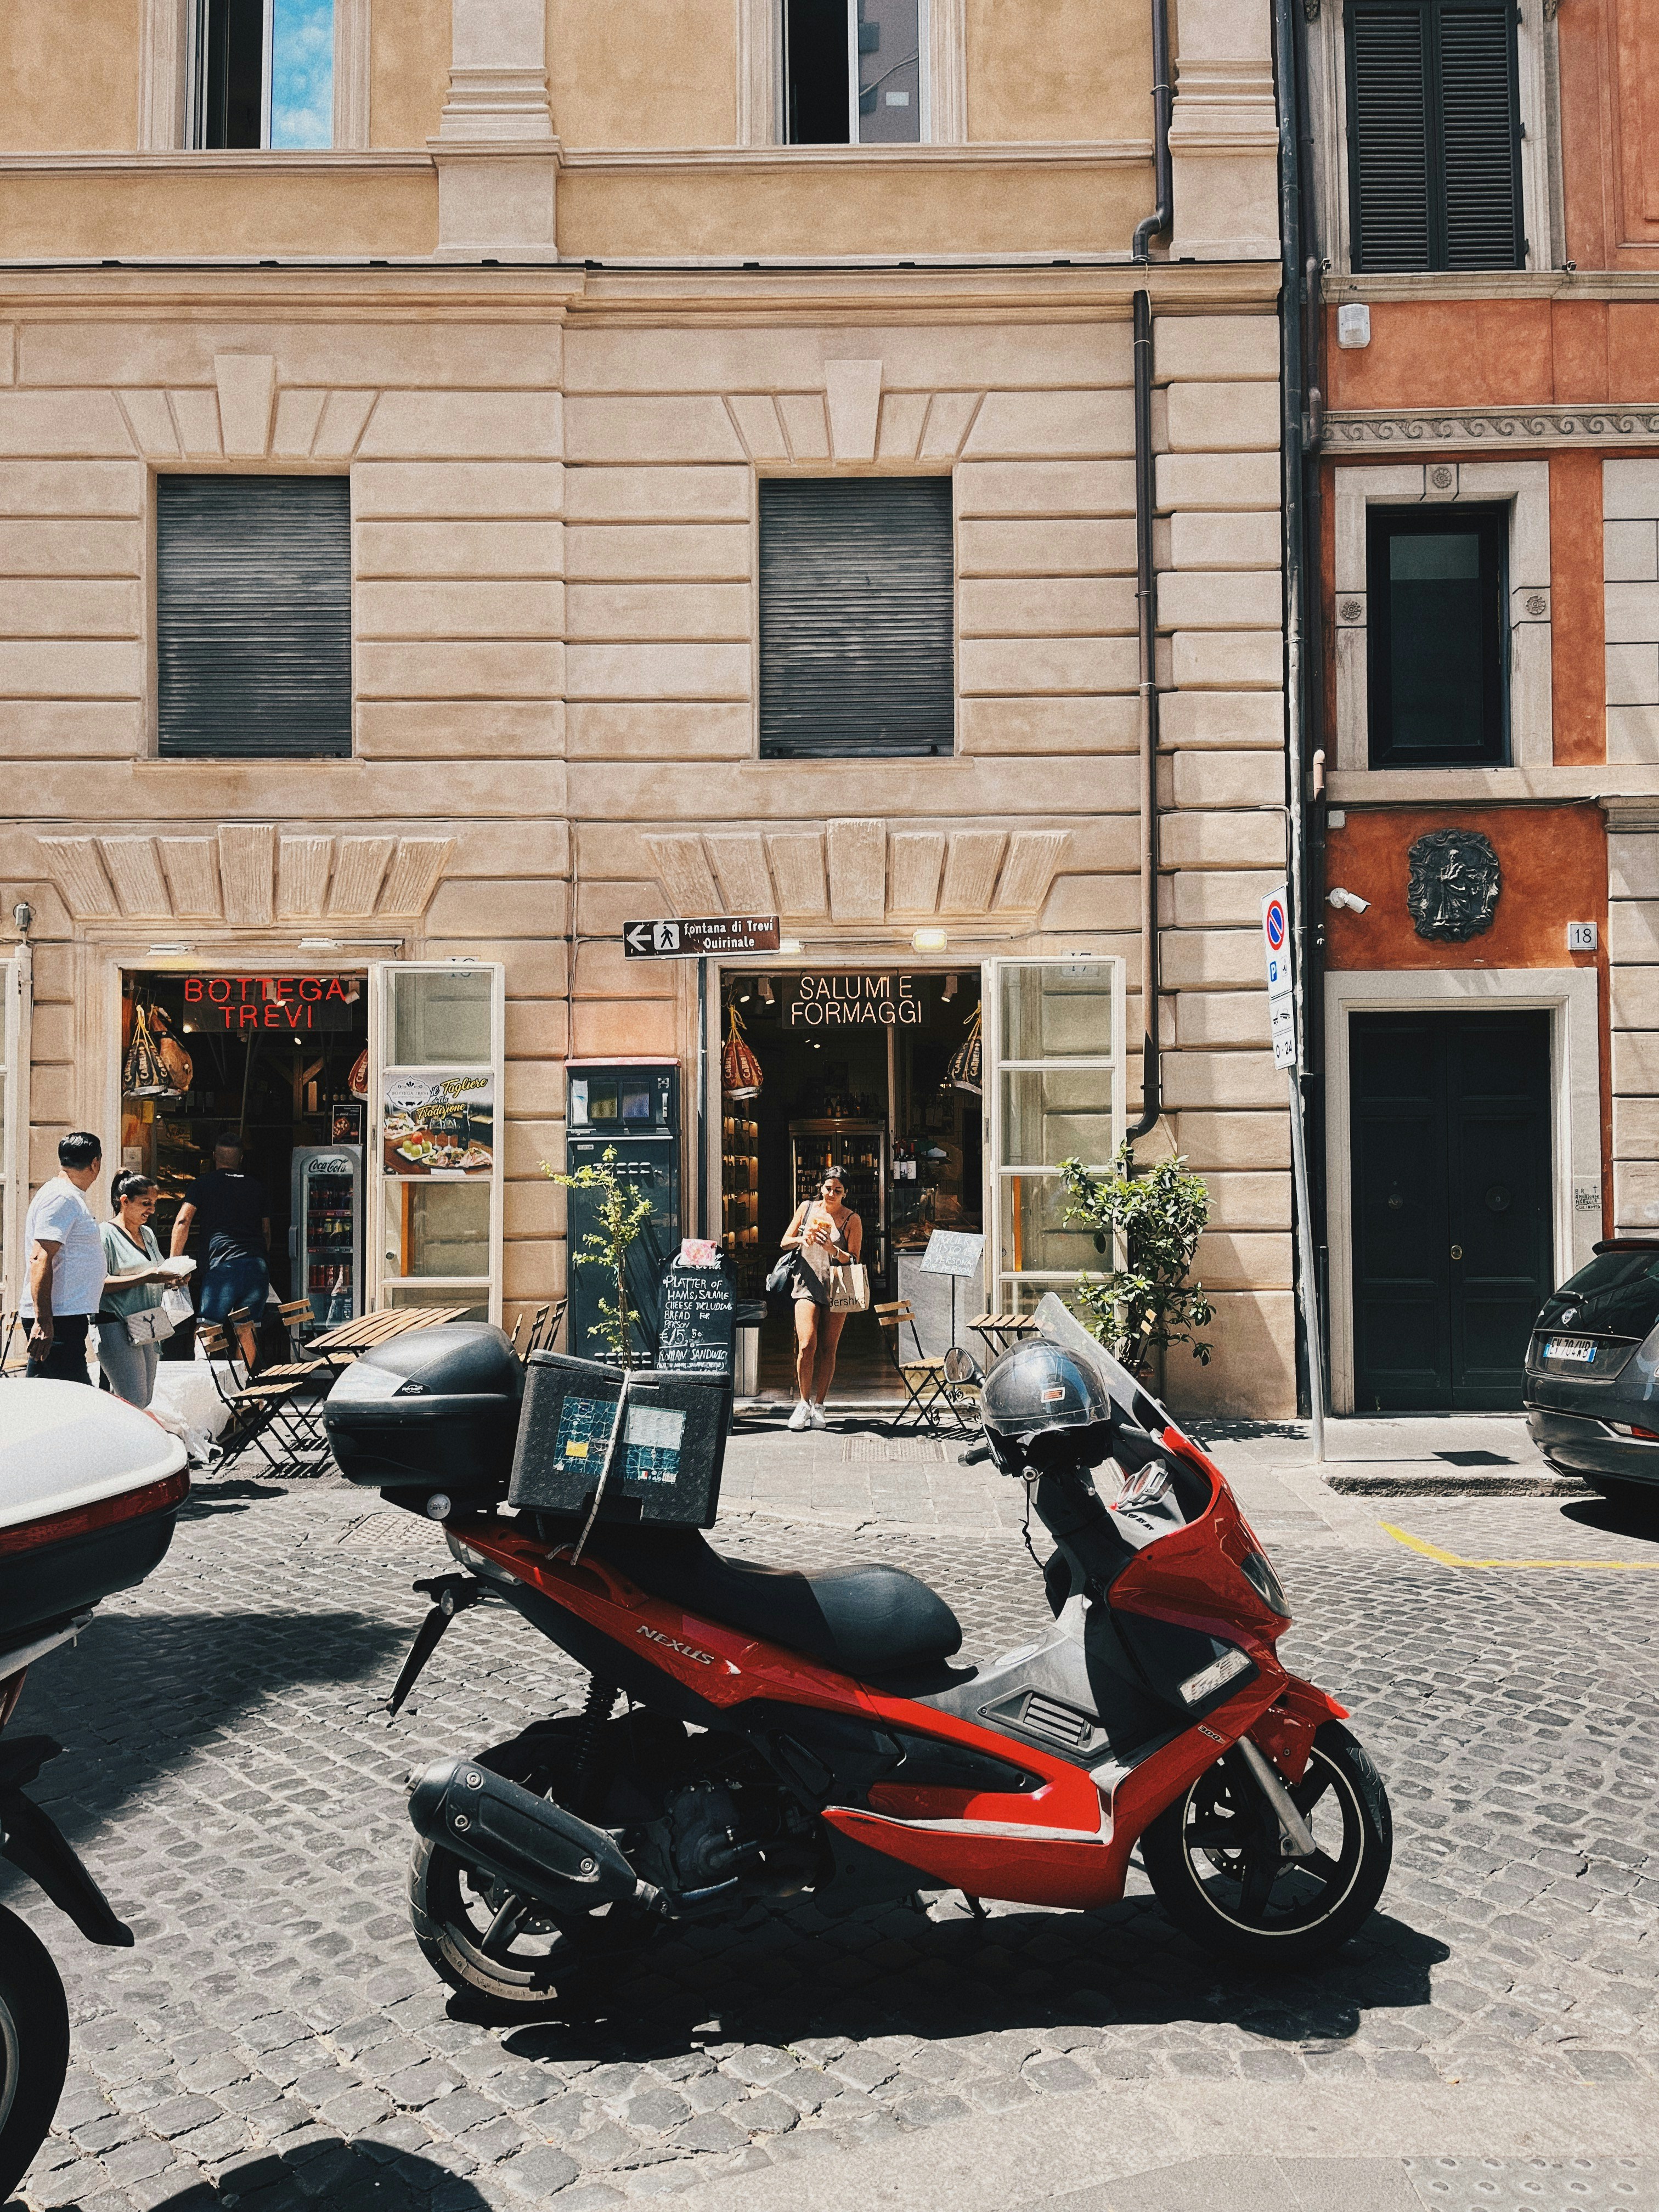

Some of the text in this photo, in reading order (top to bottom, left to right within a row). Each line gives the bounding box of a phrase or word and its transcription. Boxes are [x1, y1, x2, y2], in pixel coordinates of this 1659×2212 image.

[684, 919, 773, 935] fontana di Trevi
[704, 935, 755, 949] Quirinale
[1575, 928, 1592, 943] 18
[185, 978, 346, 1002] BOTTEGA
[800, 976, 913, 1000] SALUMI E
[218, 1005, 312, 1028] TREVI
[792, 1000, 921, 1025] FORMAGGI
[440, 1077, 488, 1098] Tagliere
[432, 1096, 449, 1104] della
[416, 1103, 465, 1120] Tradizione
[665, 1275, 723, 1290] PLATTER OF
[665, 1301, 693, 1310] CHEESE
[664, 1310, 691, 1321] BREAD
[664, 1320, 690, 1328] PERSON
[658, 1348, 688, 1361] ROMAN
[636, 1625, 714, 1664] NEXUS
